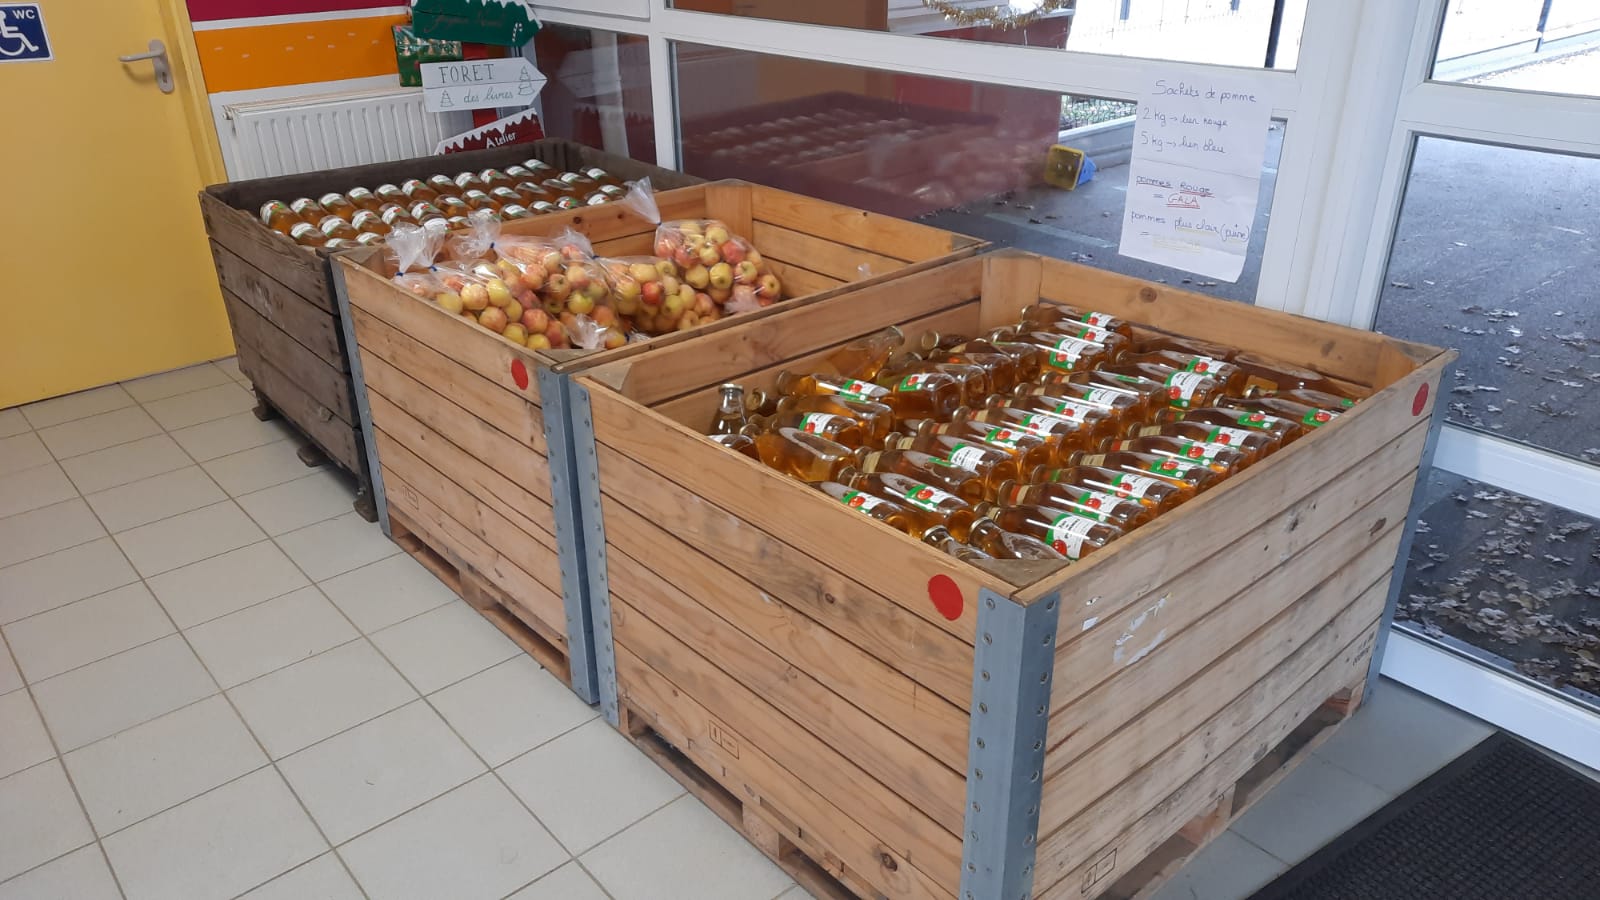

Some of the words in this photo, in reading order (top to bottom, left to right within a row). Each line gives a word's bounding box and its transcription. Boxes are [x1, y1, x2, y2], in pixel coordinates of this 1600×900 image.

[12, 9, 35, 19] WC
[438, 63, 494, 84] FORET
[463, 89, 479, 104] des
[485, 87, 514, 101] livres
[1152, 80, 1199, 98] Sachets
[1205, 87, 1216, 98] de
[1220, 93, 1257, 105] pomme
[1142, 107, 1150, 120] 2
[486, 132, 516, 149] Atelier
[1140, 131, 1149, 145] 5
[1202, 139, 1227, 154] bleu
[1131, 211, 1166, 224] pommes
[1174, 216, 1193, 231] plus
